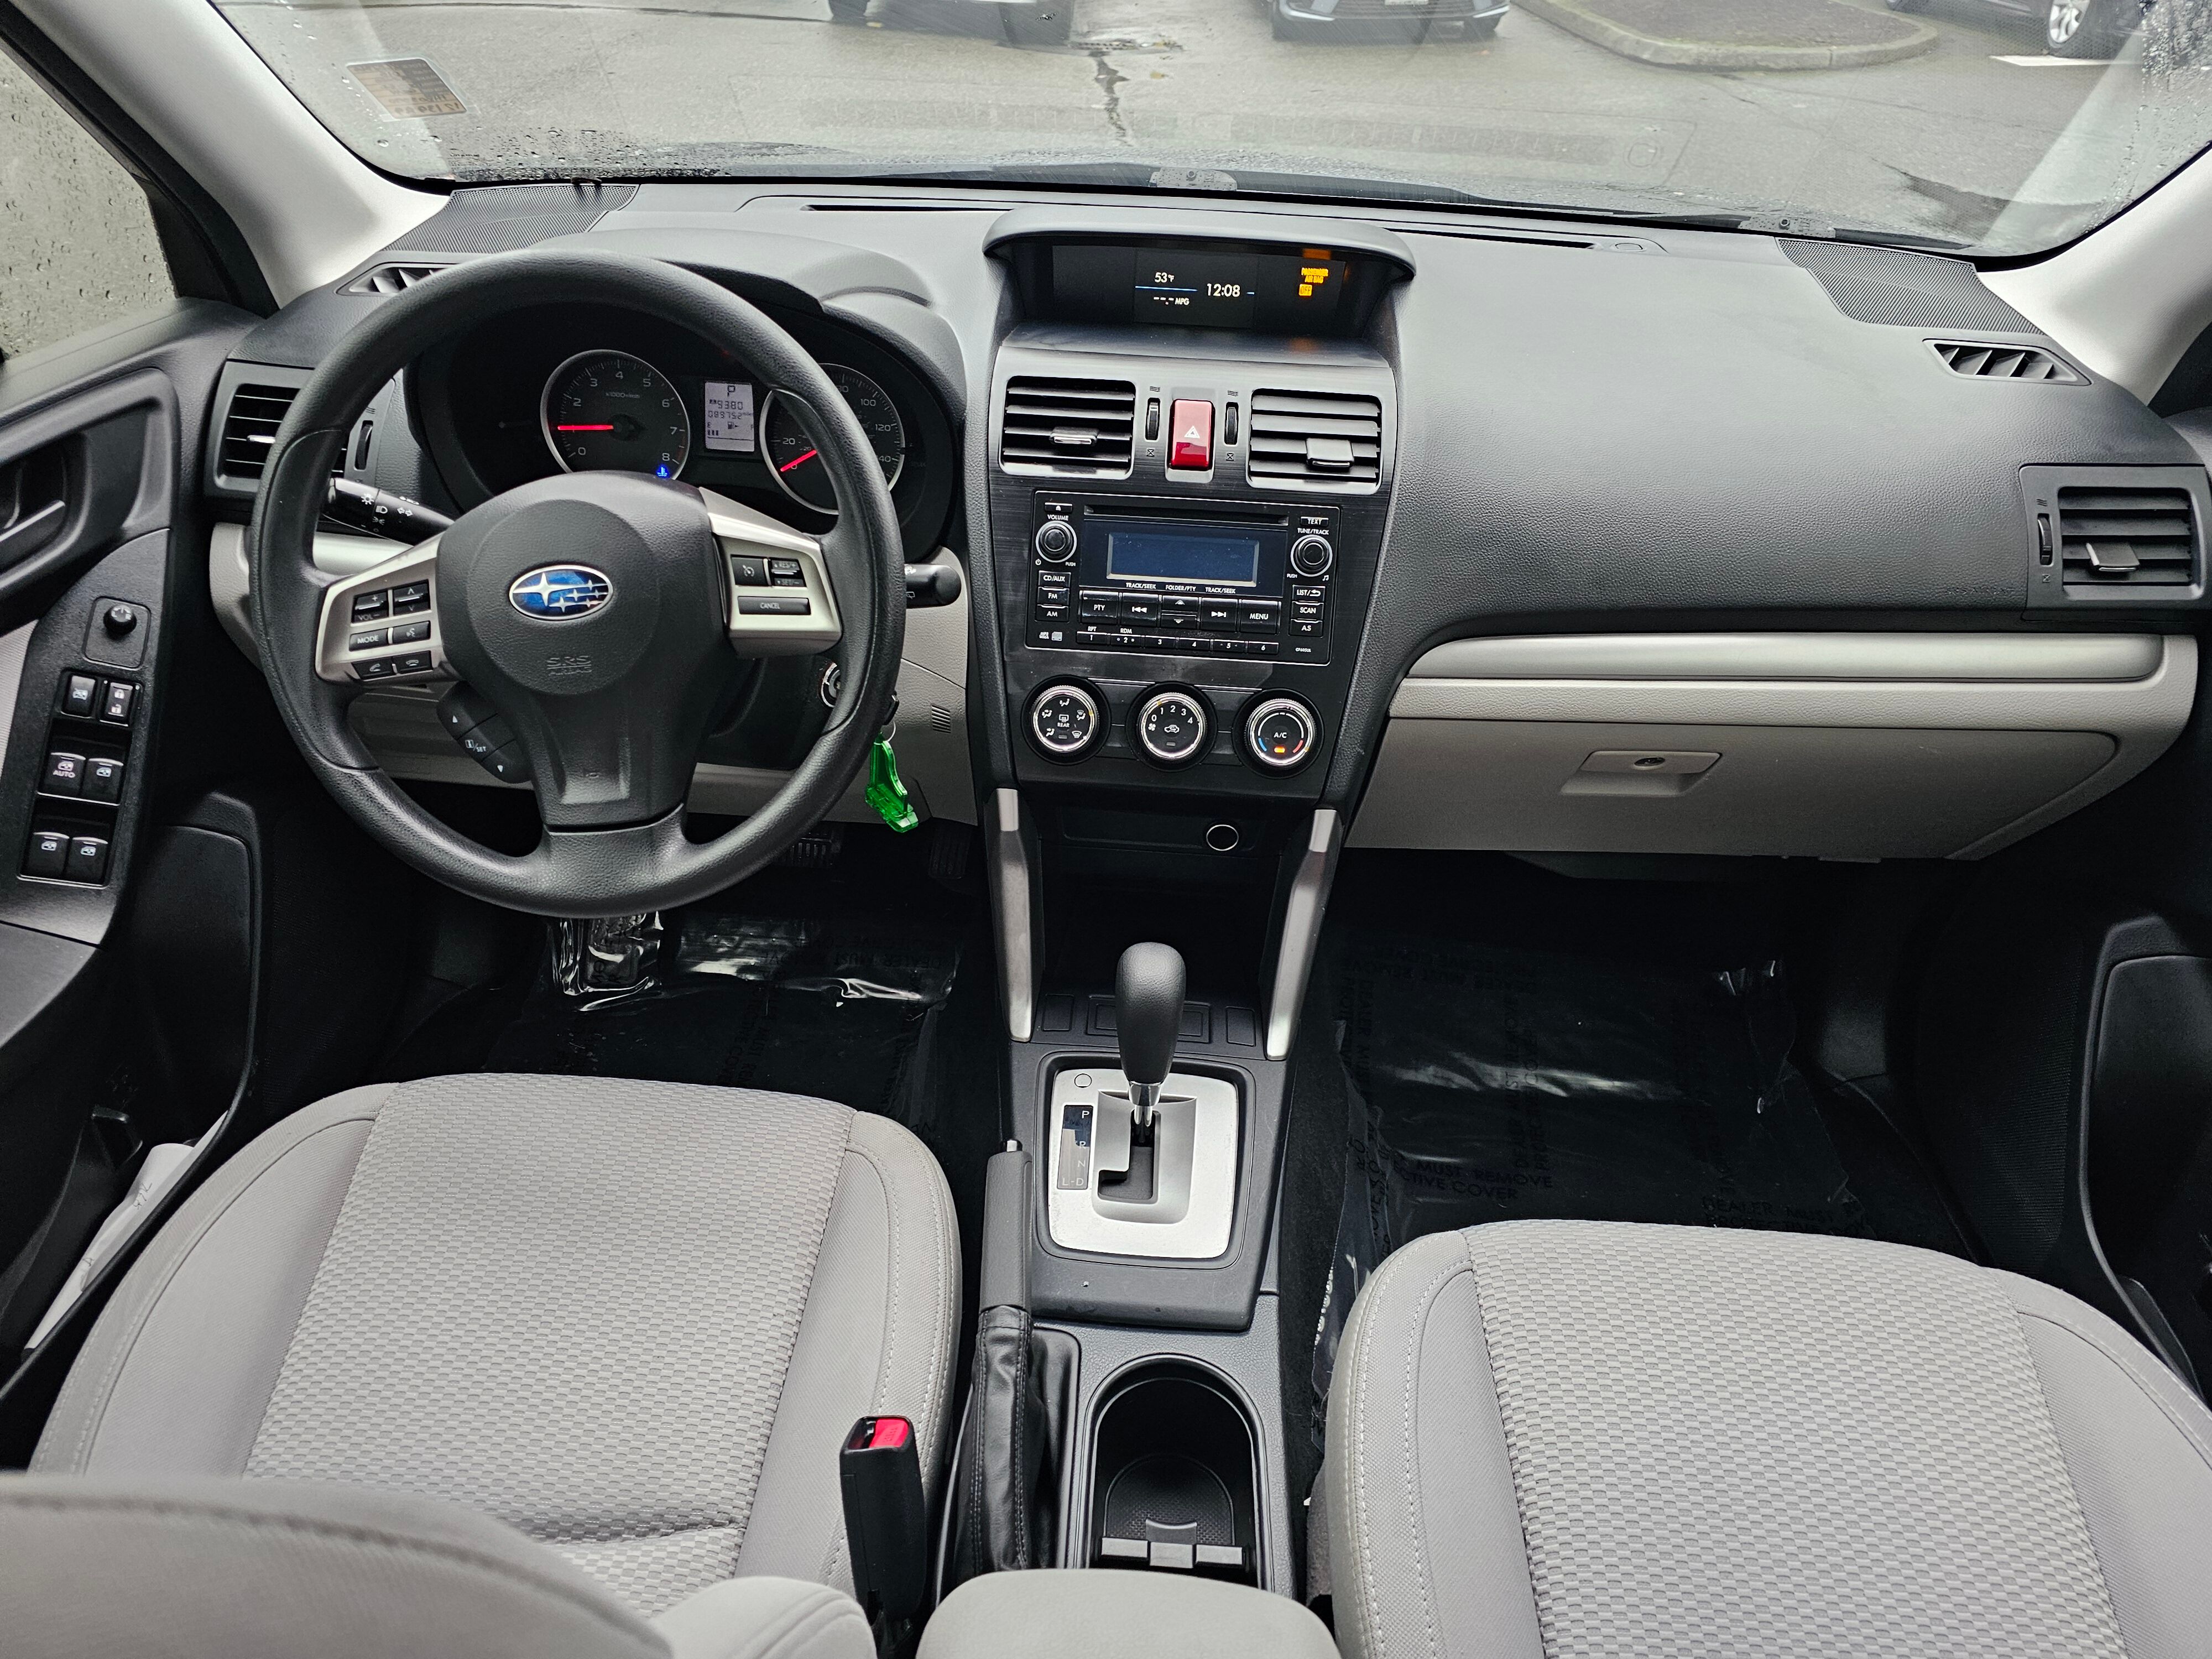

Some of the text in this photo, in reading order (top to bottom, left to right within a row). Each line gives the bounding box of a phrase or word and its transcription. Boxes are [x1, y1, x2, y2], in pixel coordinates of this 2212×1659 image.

[1207, 283, 1240, 297] 12:08
[1300, 286, 1311, 295] OFF
[615, 371, 623, 379] 4
[589, 378, 598, 387] 3
[643, 378, 651, 387] 5
[727, 385, 735, 397] P
[573, 398, 581, 406] 2
[662, 399, 670, 408] 6
[860, 398, 877, 406] 100
[670, 426, 677, 435] 7
[875, 424, 891, 432] 120
[578, 447, 586, 455] 0
[662, 452, 670, 461] 8
[357, 635, 379, 644] MODE
[546, 655, 592, 667] SRS
[53, 770, 76, 778] AUTO
[1082, 1110, 1090, 1119] P
[1079, 1141, 1087, 1149] R
[1416, 1160, 1553, 1189] MUST REMOVE
[1452, 1181, 1519, 1199] COVER
